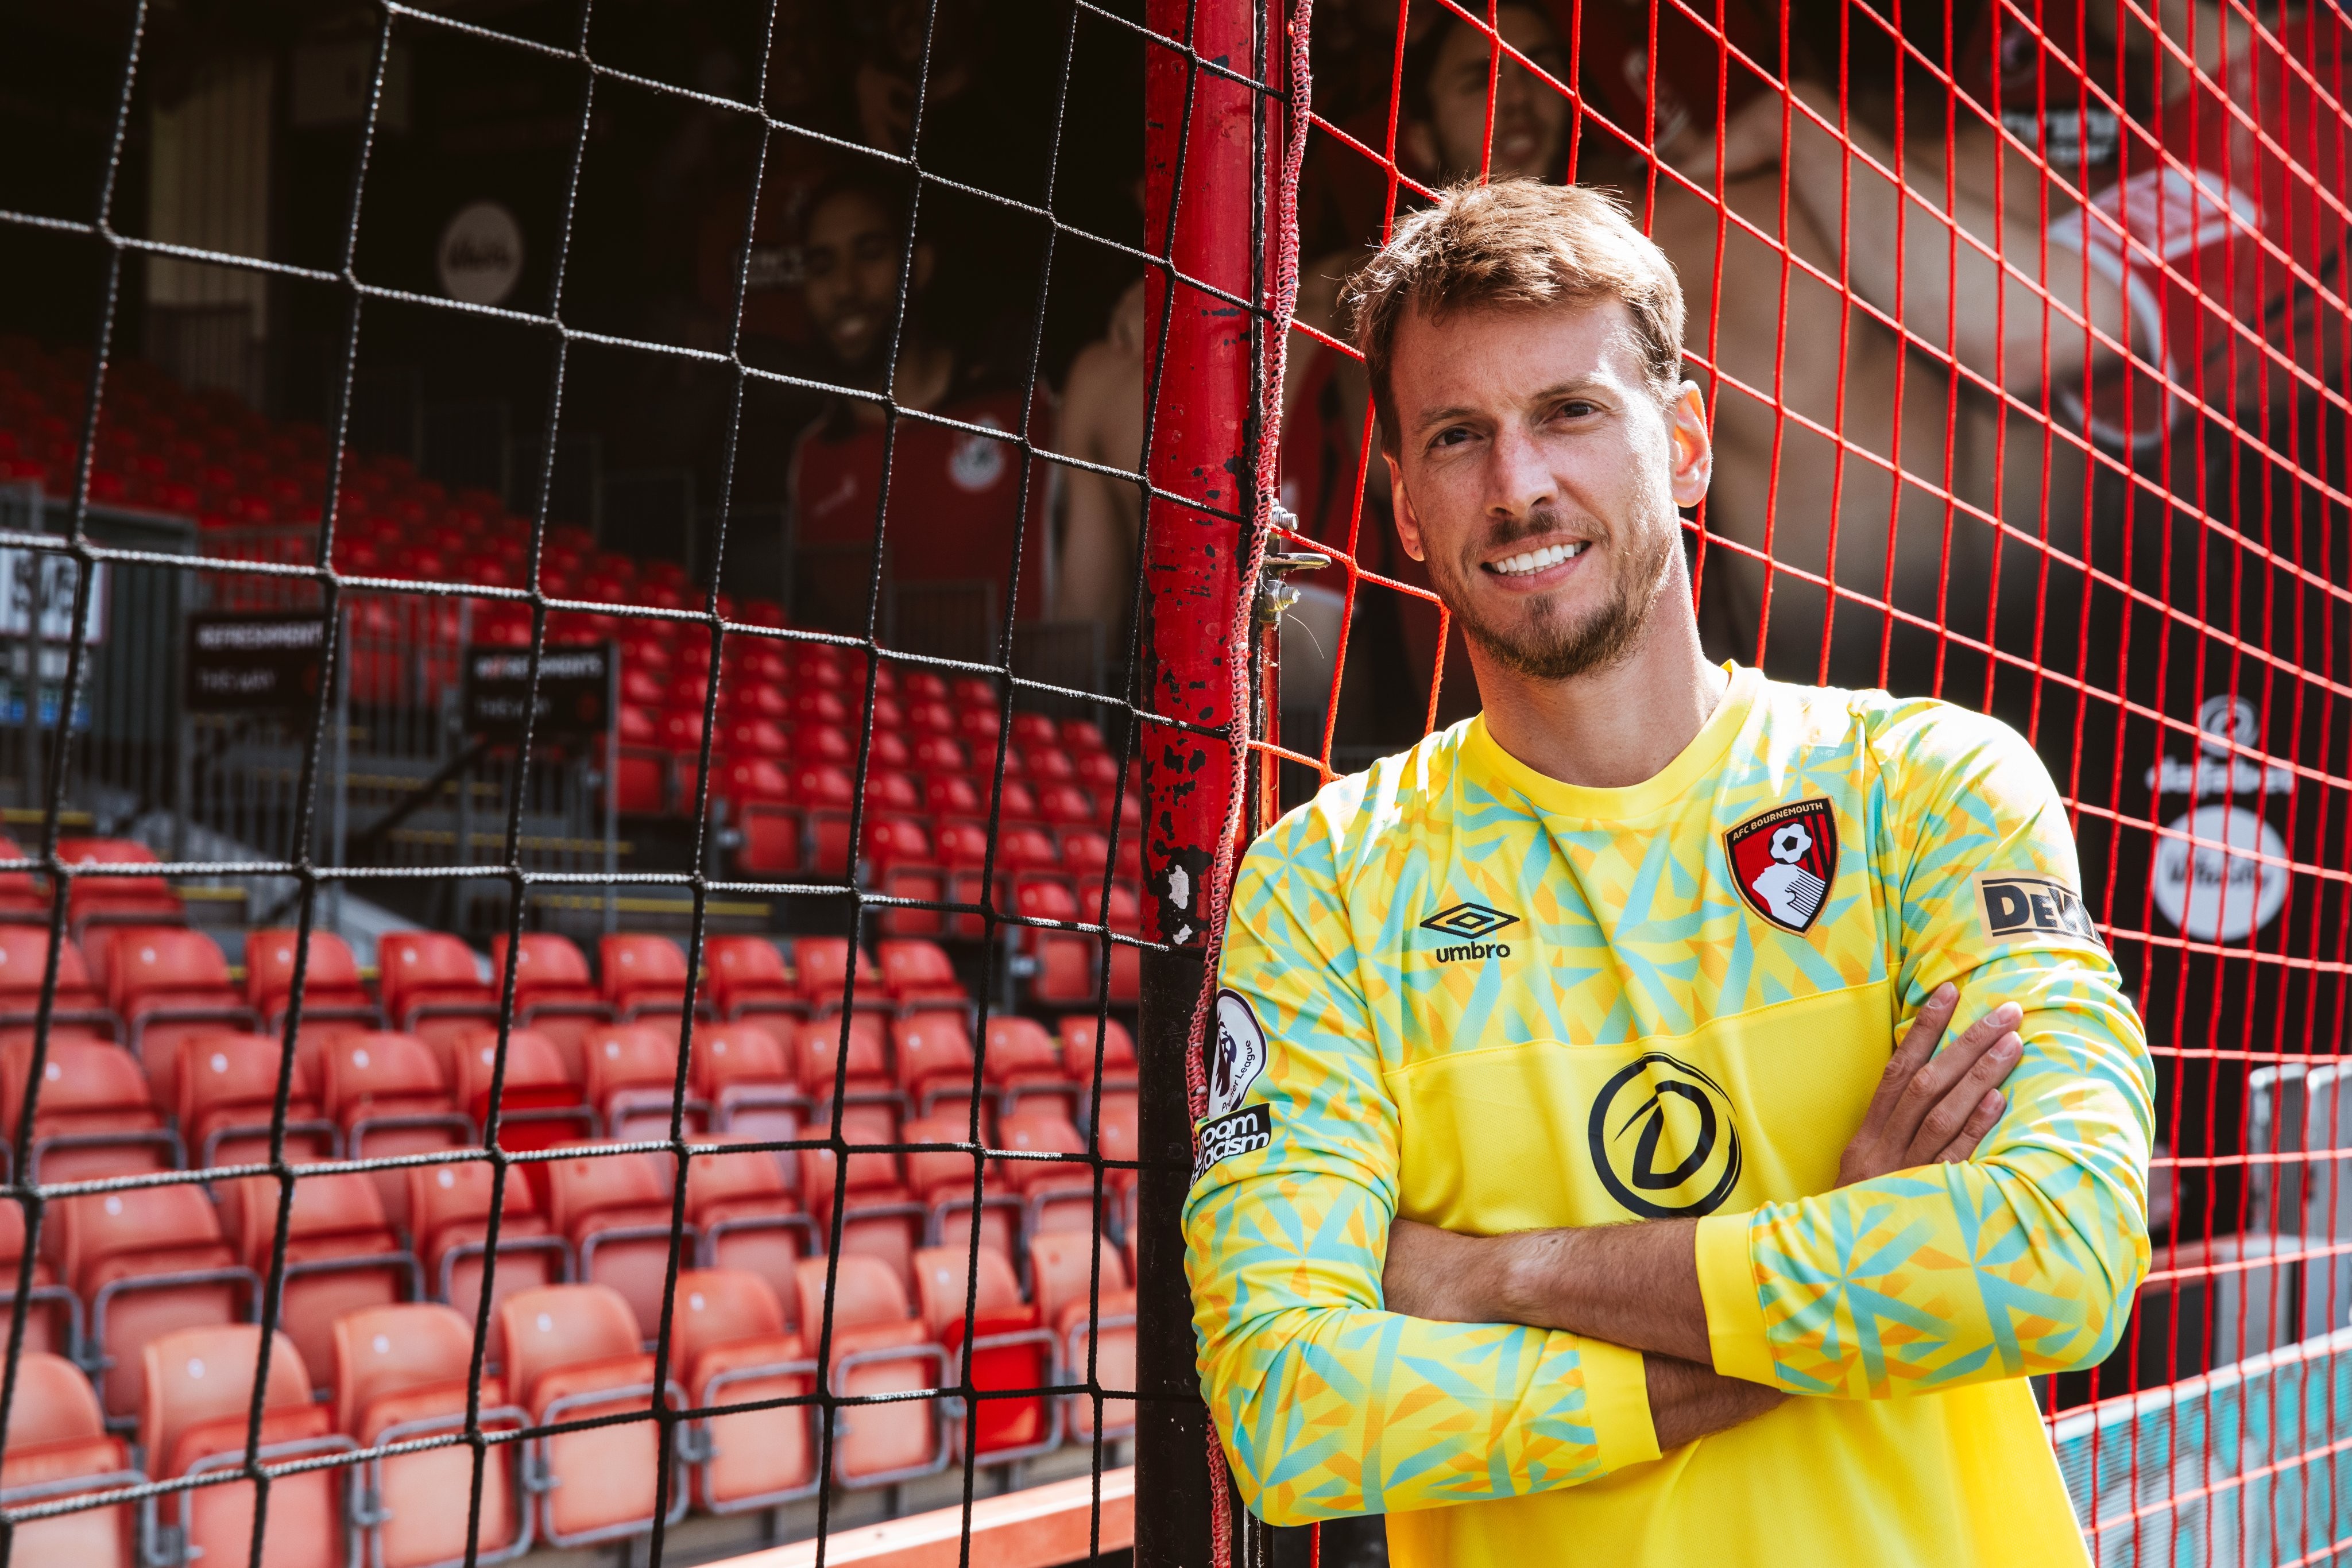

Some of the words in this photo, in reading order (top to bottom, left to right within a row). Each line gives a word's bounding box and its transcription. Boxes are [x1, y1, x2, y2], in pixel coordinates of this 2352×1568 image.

[1733, 826, 1749, 841] AFC
[1751, 802, 1823, 830] BOURNEMOUTH
[1983, 885, 2104, 943] DEW
[1436, 942, 1511, 963] umbro
[1235, 1040, 1255, 1079] League
[1201, 1113, 1258, 1154] room
